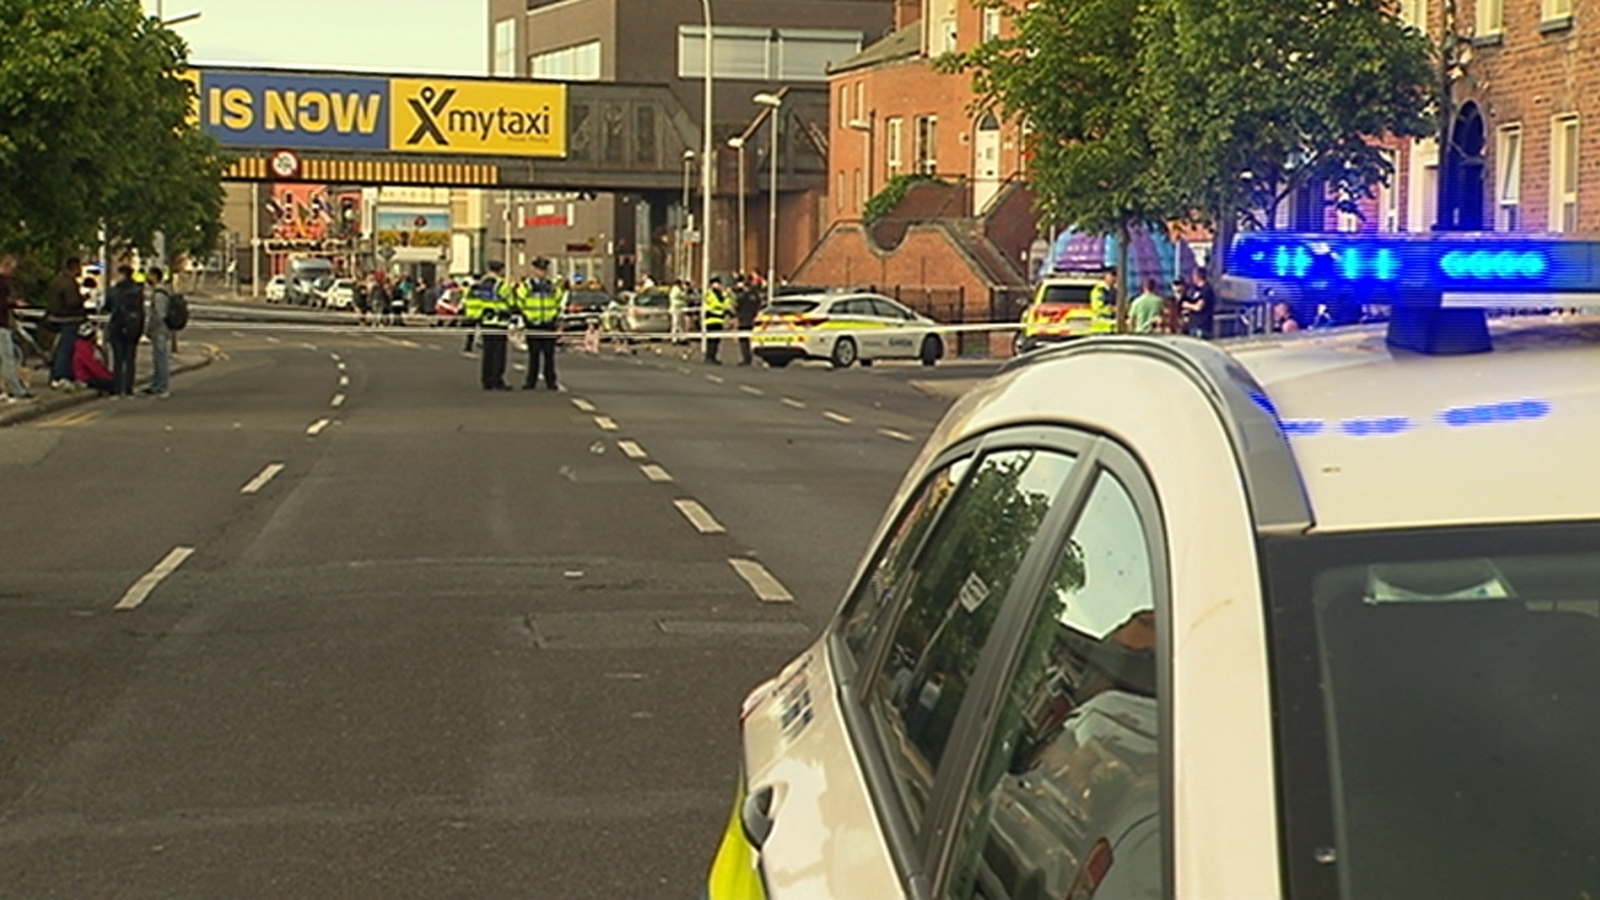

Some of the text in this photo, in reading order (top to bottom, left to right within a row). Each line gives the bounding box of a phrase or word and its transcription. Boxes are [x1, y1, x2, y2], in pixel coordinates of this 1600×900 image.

[208, 87, 381, 134] IS NOW
[448, 105, 550, 142] mytaxi
